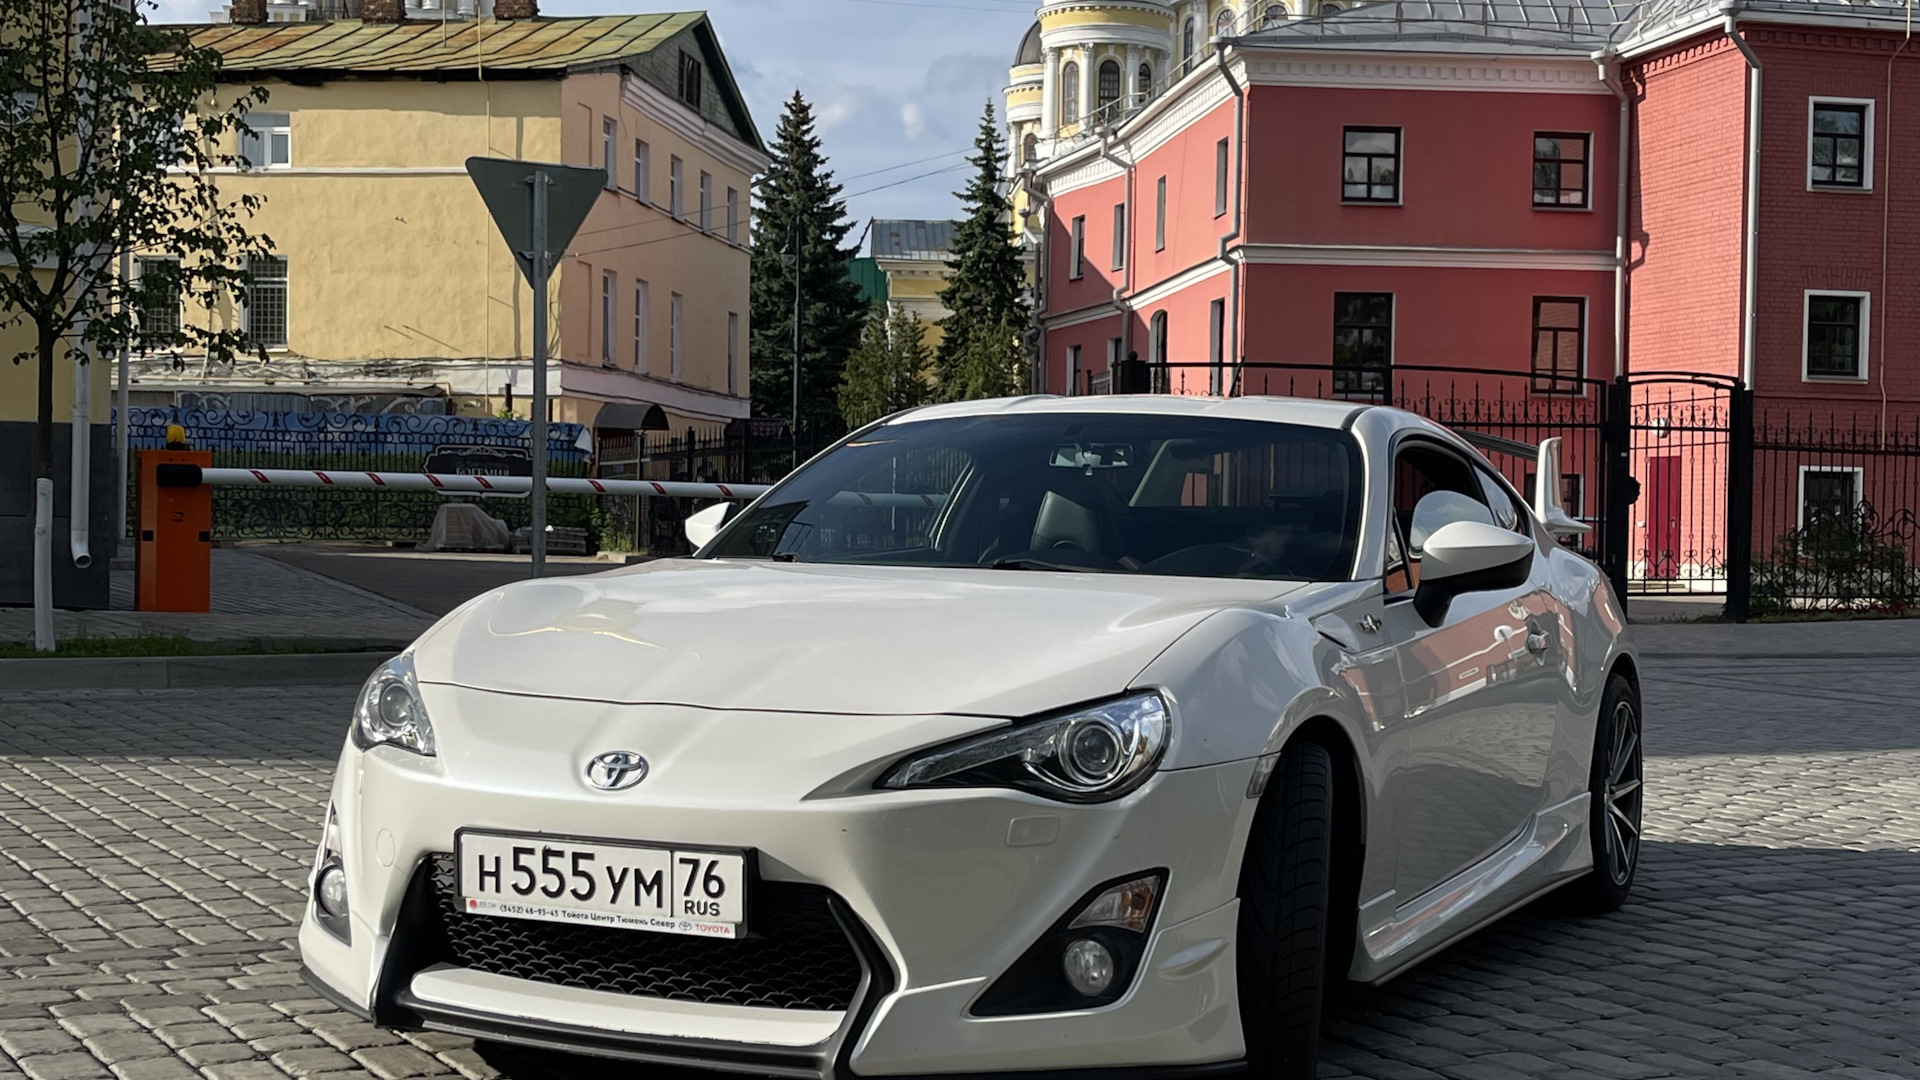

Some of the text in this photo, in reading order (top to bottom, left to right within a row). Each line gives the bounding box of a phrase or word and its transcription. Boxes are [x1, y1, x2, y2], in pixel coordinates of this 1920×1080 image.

[679, 858, 725, 898] 76
[684, 900, 720, 916] RUS
[561, 910, 588, 920] Тойота
[590, 913, 615, 923] Центр
[616, 915, 648, 925] Тюмень
[650, 918, 675, 929] Север
[695, 924, 731, 934] TOYOTA
